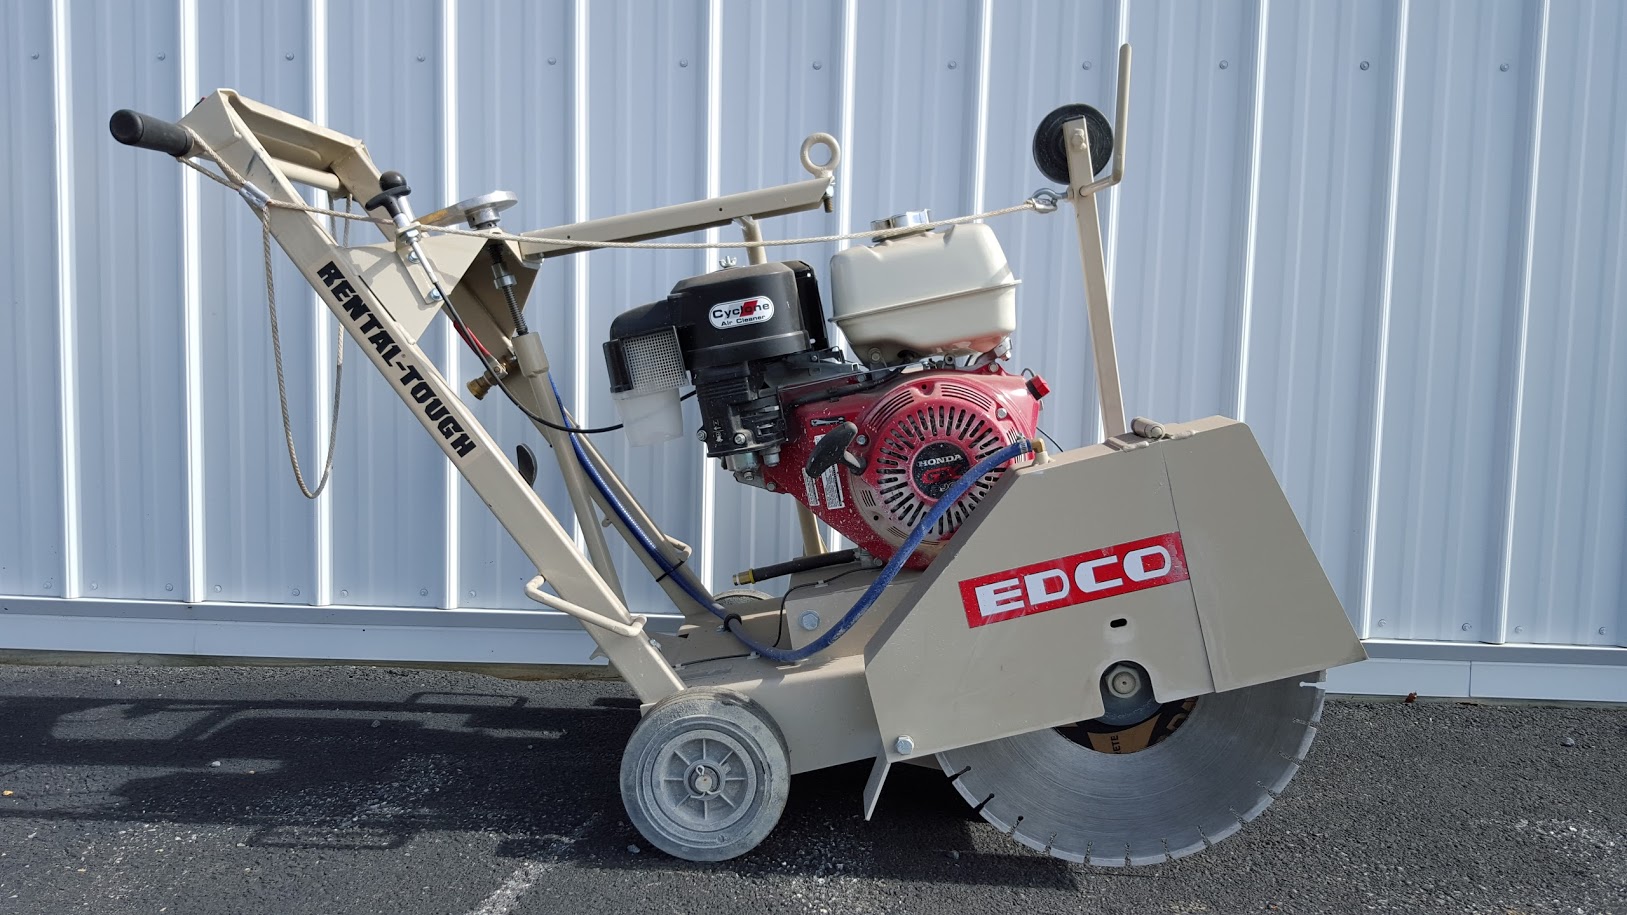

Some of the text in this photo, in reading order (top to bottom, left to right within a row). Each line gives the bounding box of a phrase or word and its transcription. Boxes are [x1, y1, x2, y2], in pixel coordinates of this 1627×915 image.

[713, 303, 770, 319] Cyclone
[736, 315, 766, 324] Cleaner
[917, 454, 963, 467] HONDA
[975, 545, 1172, 617] EDCO
